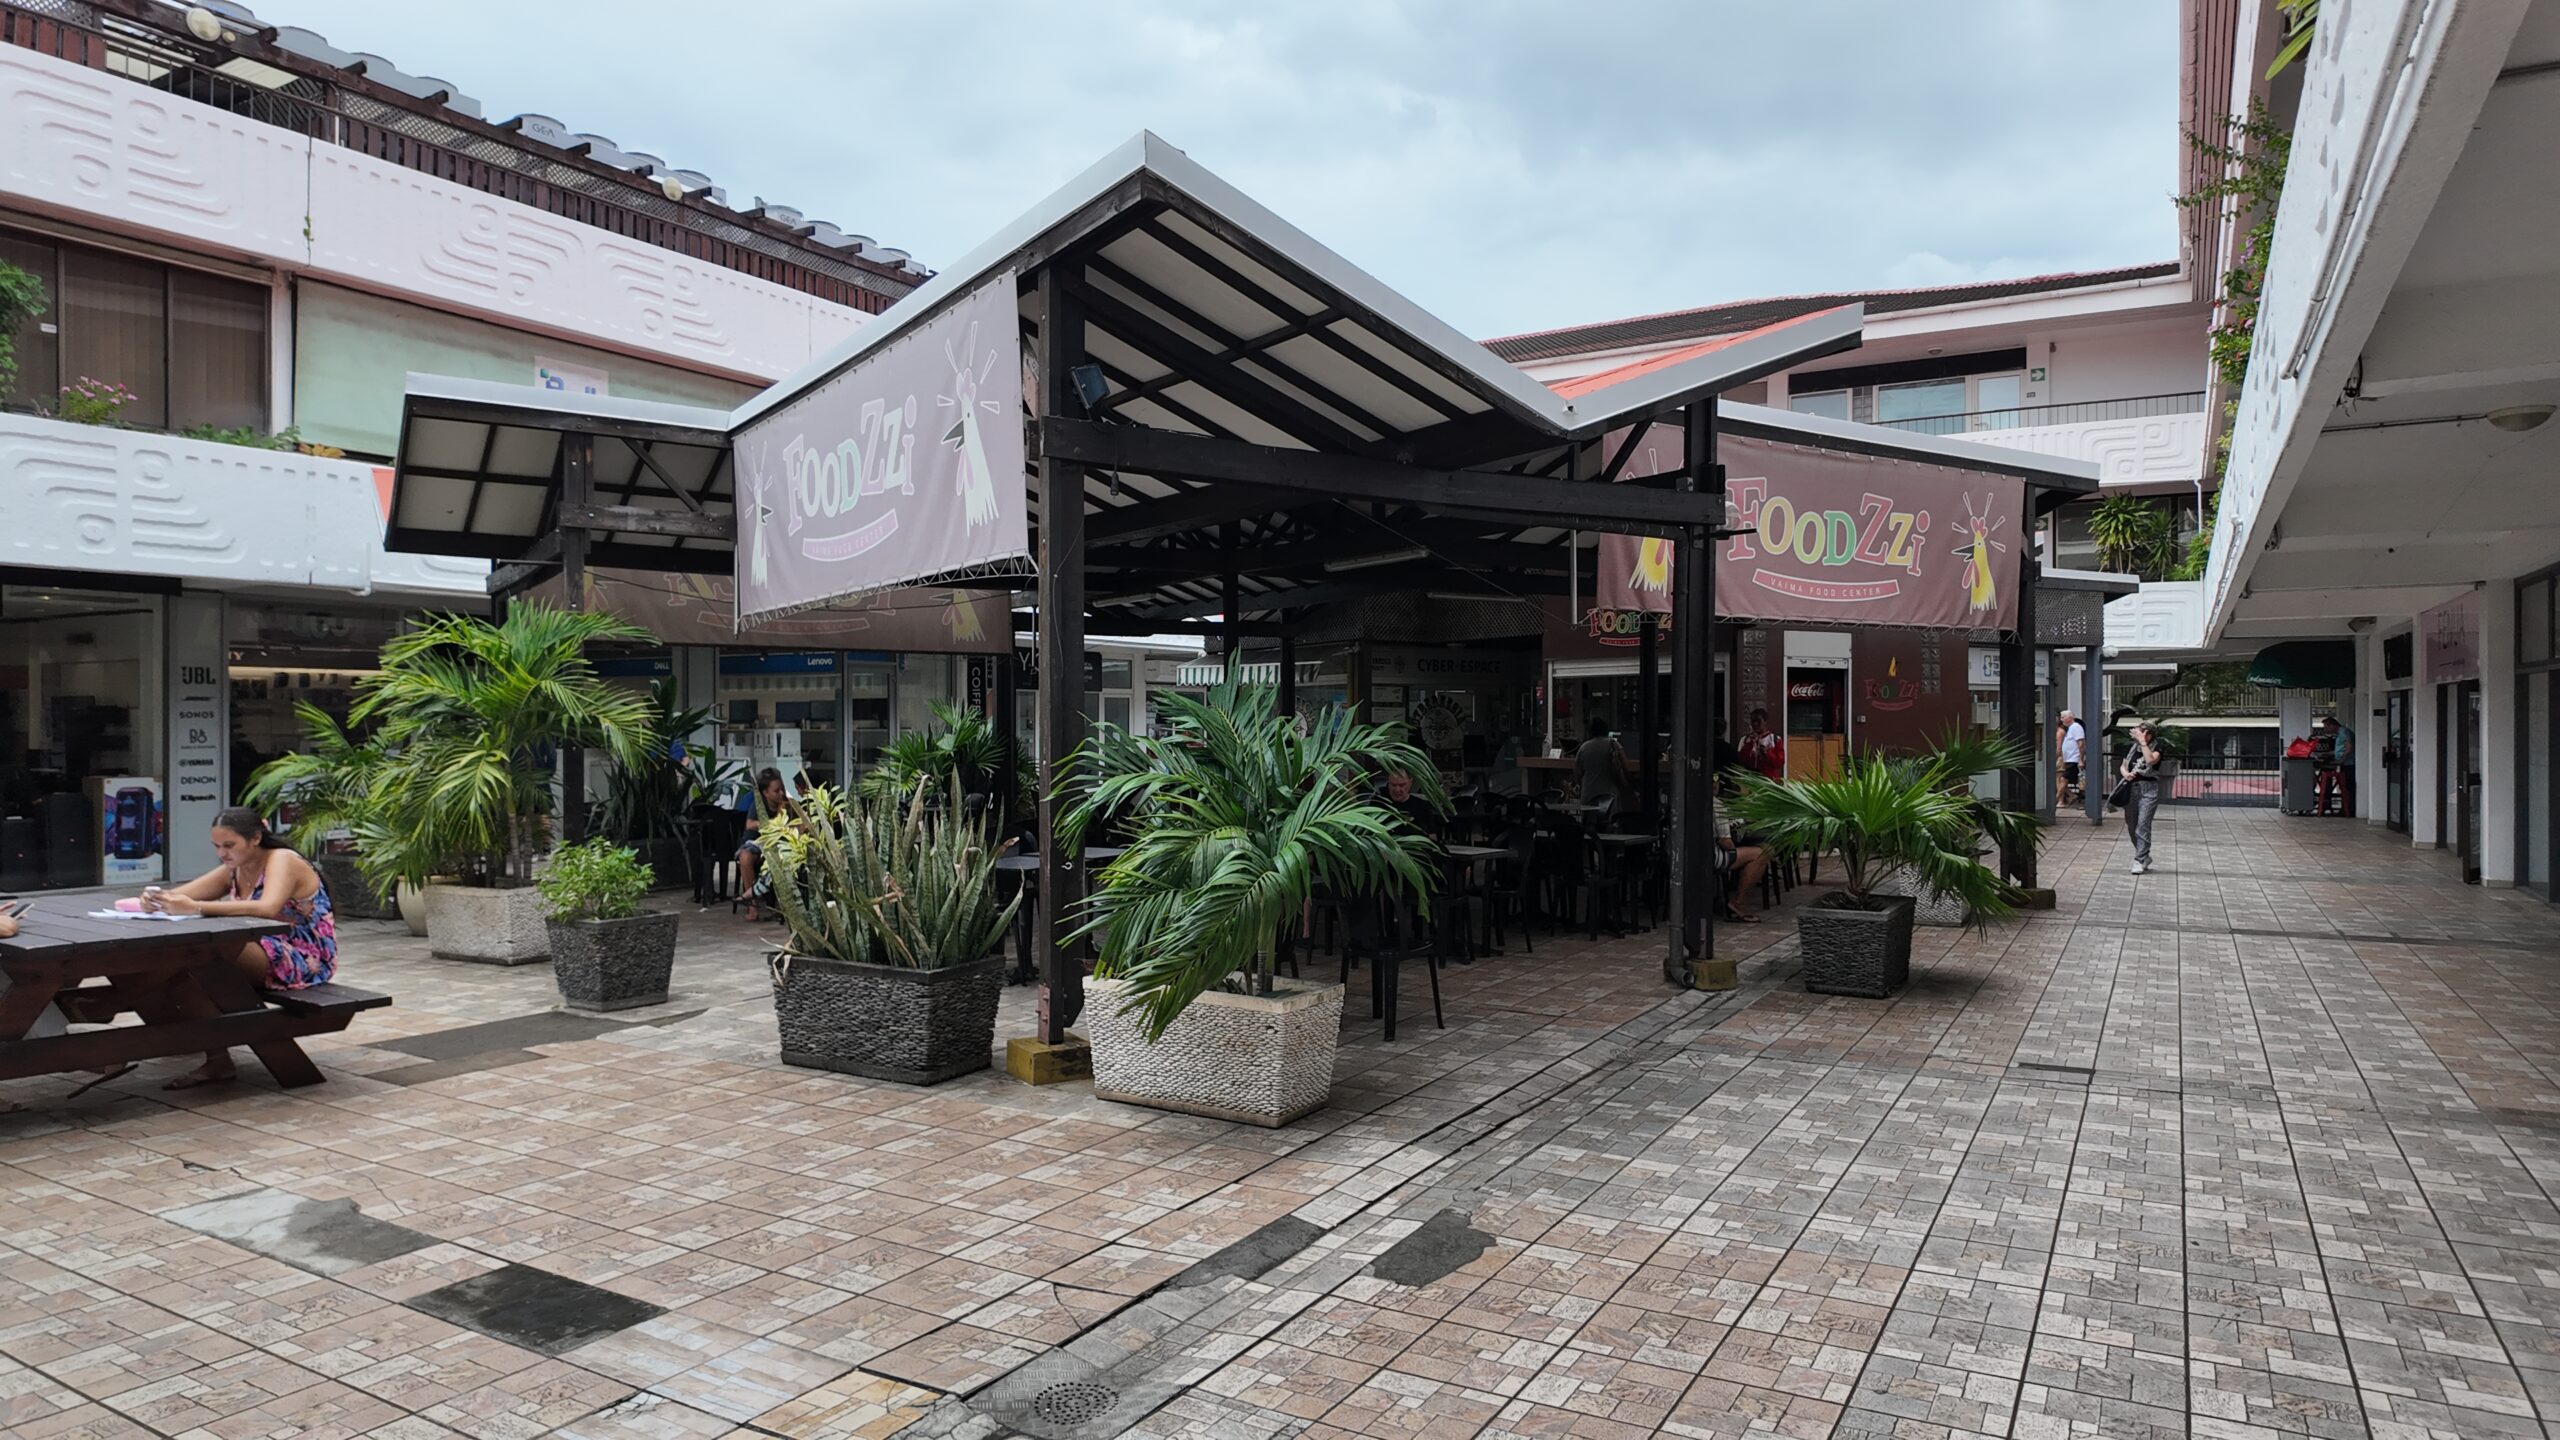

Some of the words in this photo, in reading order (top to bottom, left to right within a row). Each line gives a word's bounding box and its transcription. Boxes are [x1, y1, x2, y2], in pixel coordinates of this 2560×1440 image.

[1771, 578, 1803, 593] VAIMA
[1809, 586, 1836, 597] FOOD
[1842, 586, 1881, 597] CENTER
[808, 657, 833, 666] Lenovo
[181, 666, 216, 685] JBL
[179, 711, 214, 719] SONOS
[181, 776, 216, 785] DENON
